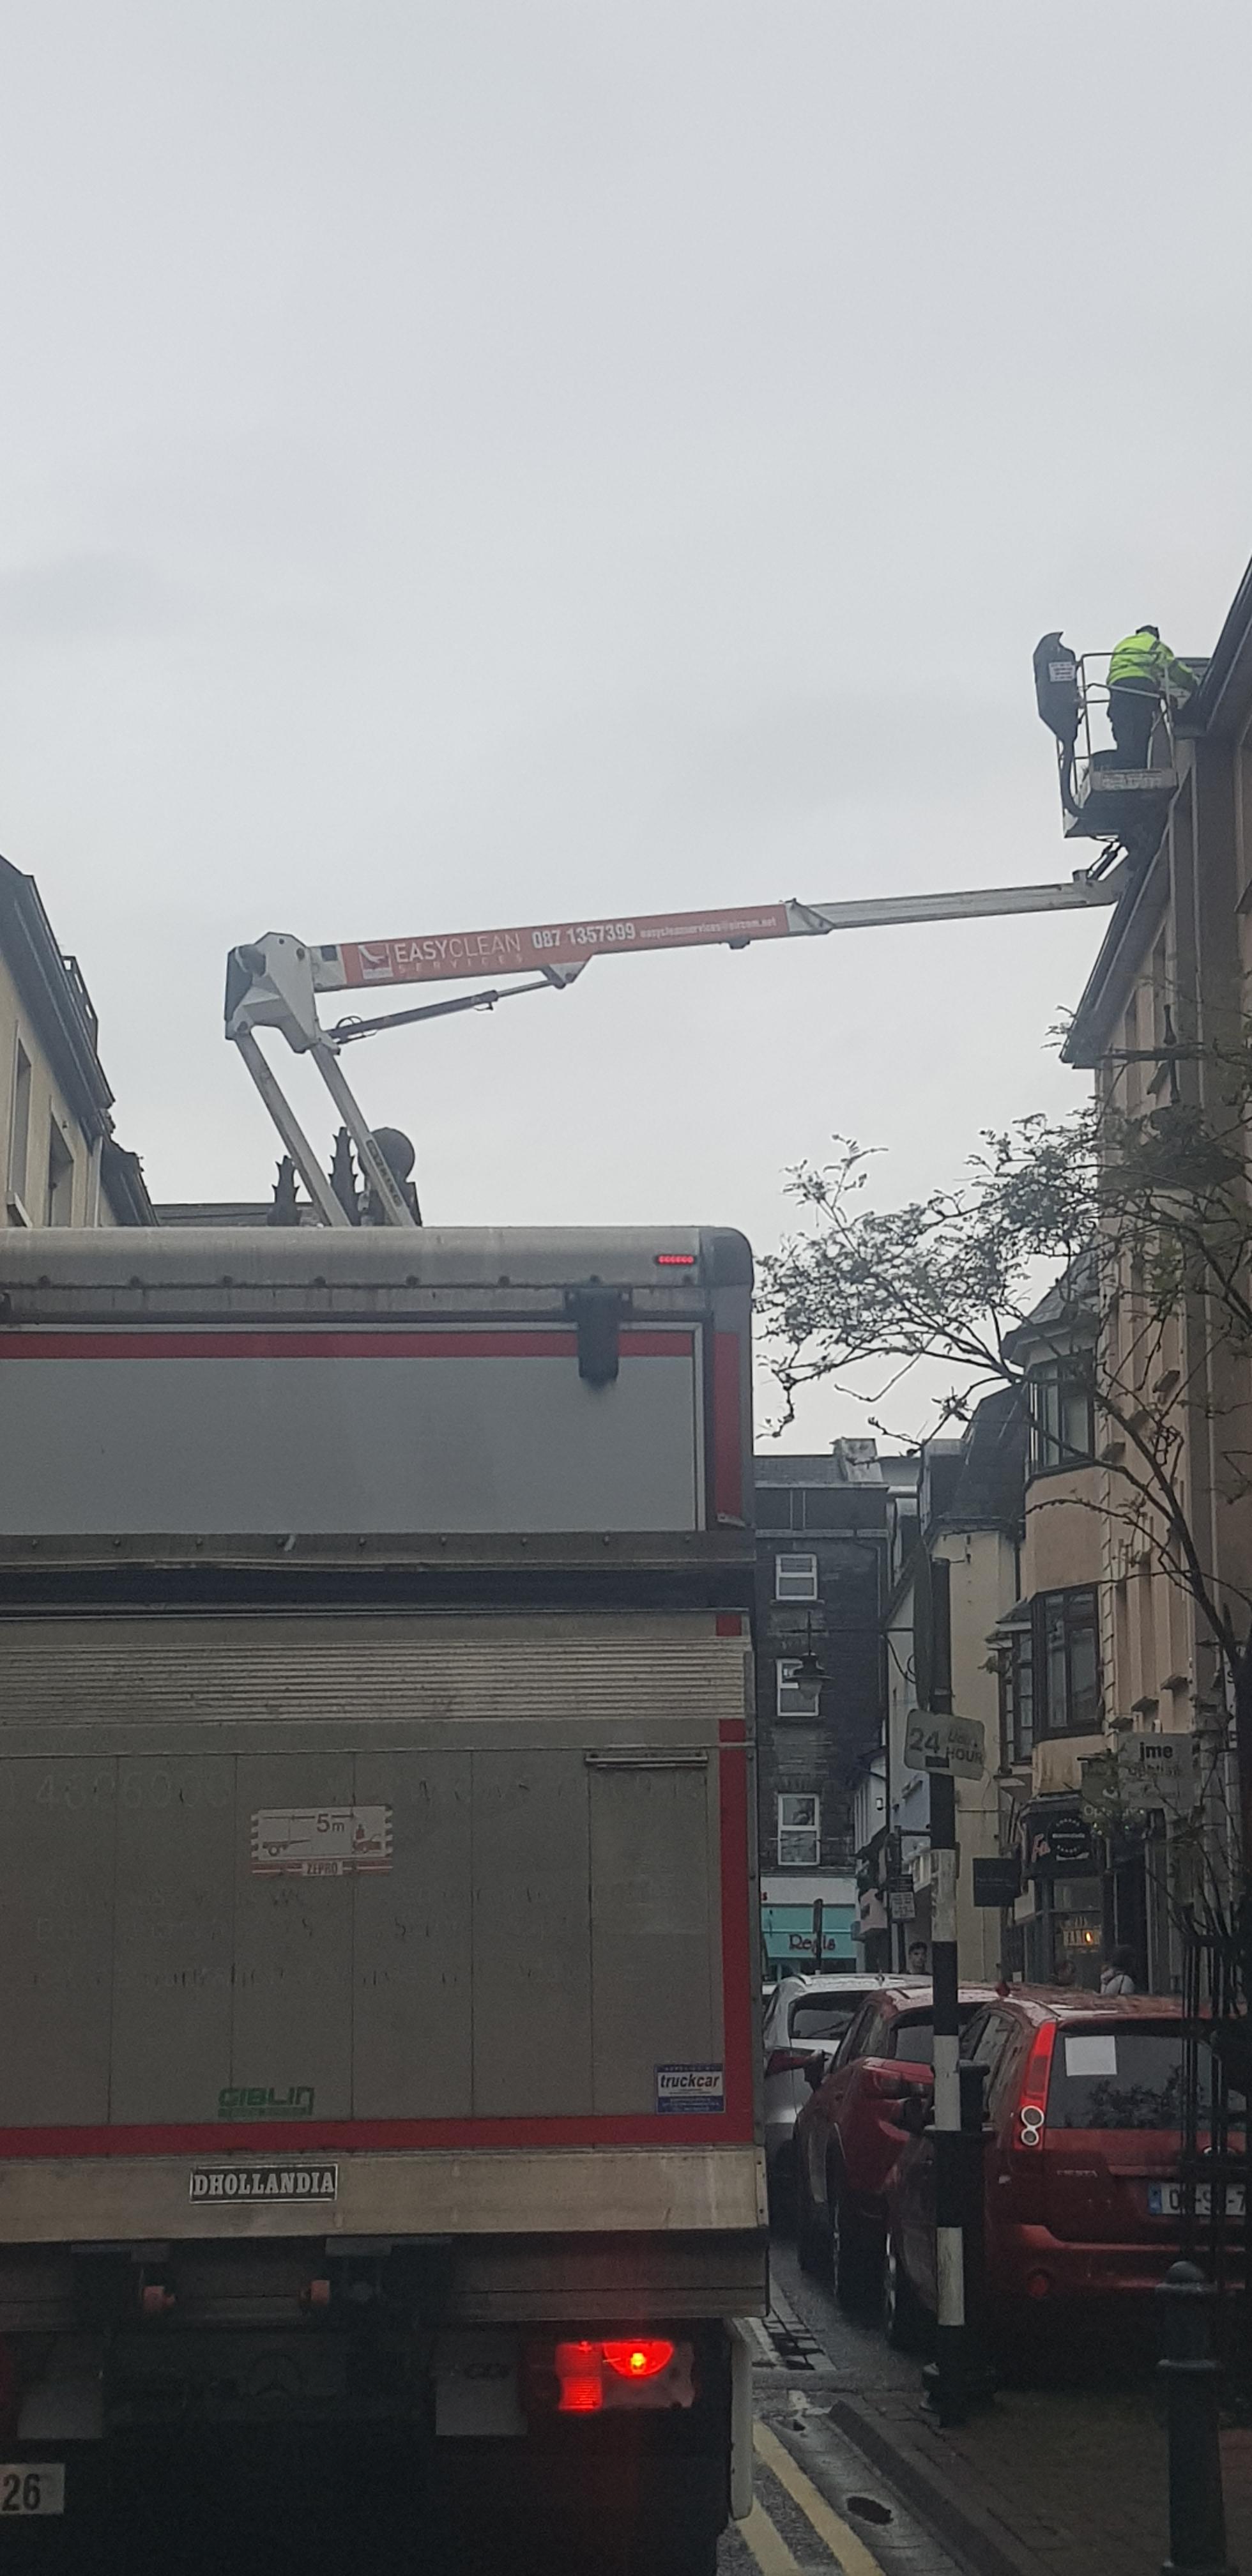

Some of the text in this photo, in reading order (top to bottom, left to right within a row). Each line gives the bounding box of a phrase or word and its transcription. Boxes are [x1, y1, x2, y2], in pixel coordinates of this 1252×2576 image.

[395, 933, 521, 963] EASYCLEAN
[531, 930, 561, 949] 087
[567, 923, 636, 945] 1357399
[399, 954, 524, 974] SERVICES
[909, 1726, 941, 1754] 24
[945, 1746, 983, 1765] HOUR
[1139, 1742, 1173, 1761] jme
[306, 1862, 339, 1875] ZEPRO
[660, 2073, 720, 2088] truckcar
[193, 2172, 334, 2196] DHOLLANDIA
